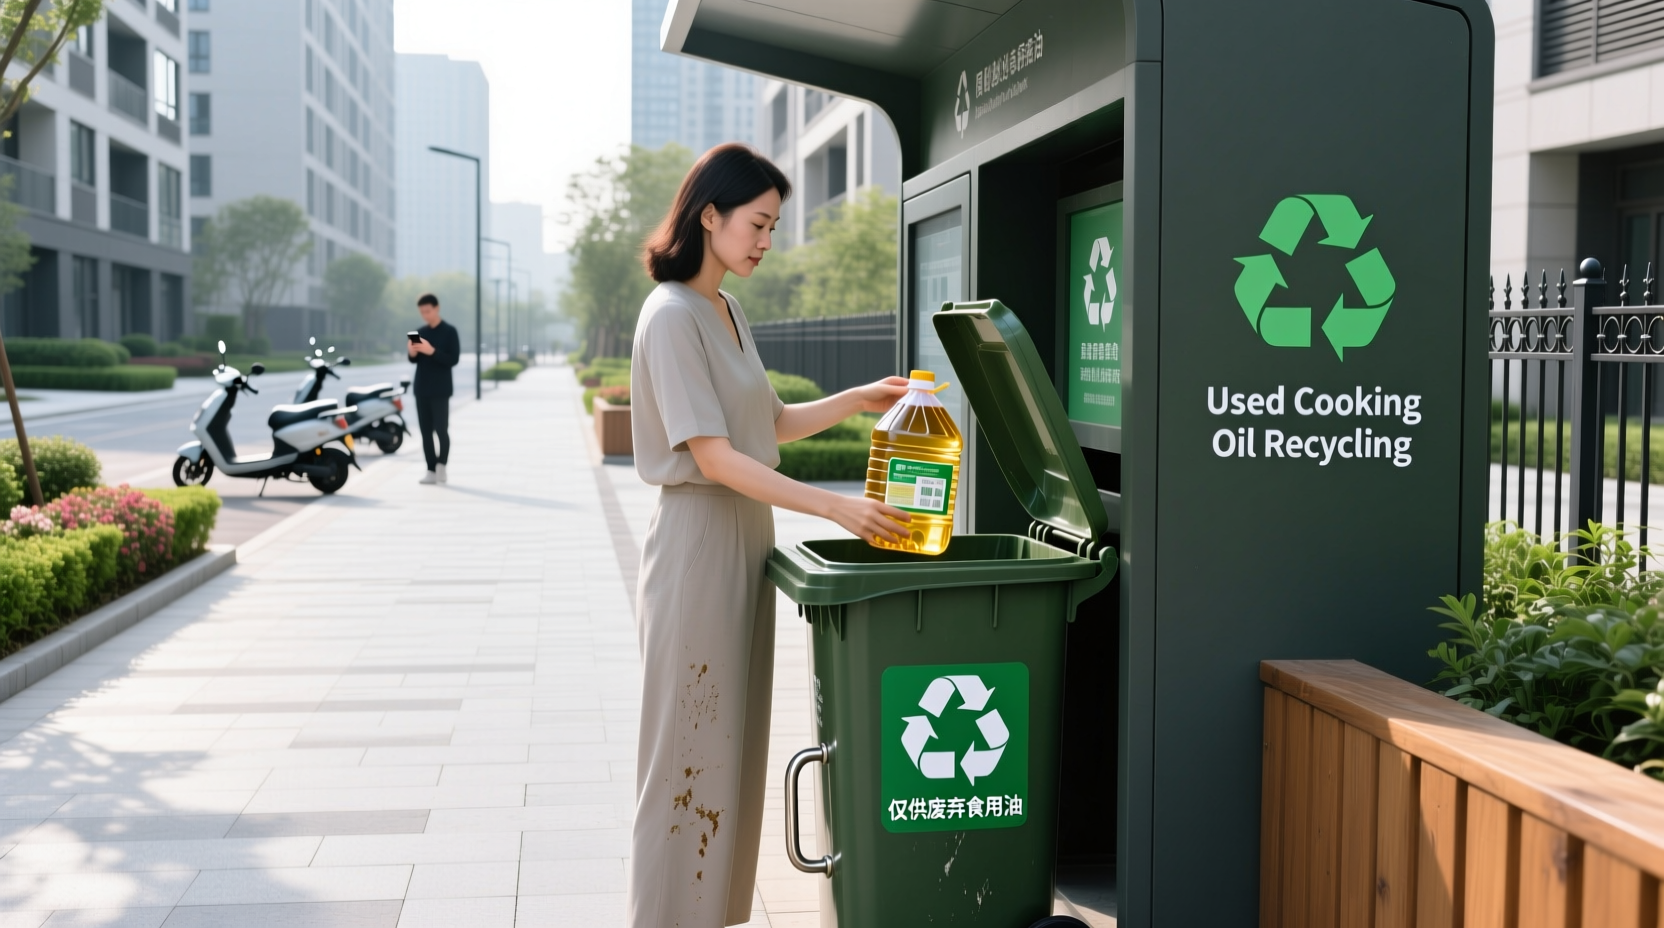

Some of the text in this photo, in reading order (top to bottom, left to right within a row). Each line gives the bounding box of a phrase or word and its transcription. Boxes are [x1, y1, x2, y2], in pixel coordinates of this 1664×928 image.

[1207, 385, 1422, 425] Used Cooking
[1212, 427, 1413, 467] Oil Recycling
[887, 793, 1023, 822] 仅供废弃食用油
